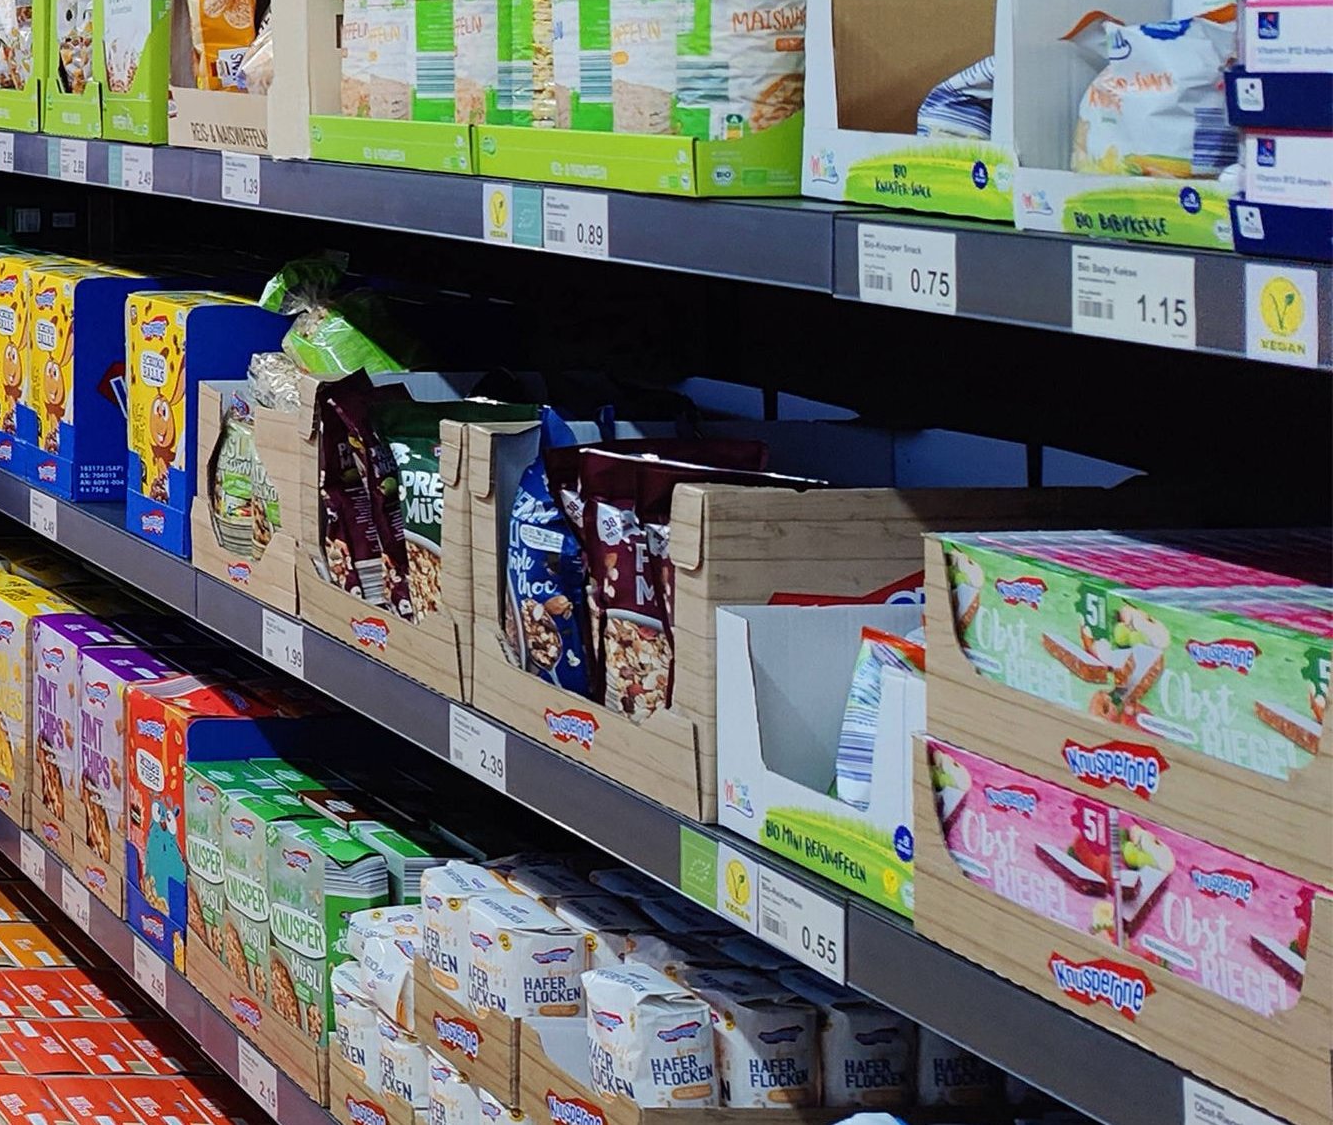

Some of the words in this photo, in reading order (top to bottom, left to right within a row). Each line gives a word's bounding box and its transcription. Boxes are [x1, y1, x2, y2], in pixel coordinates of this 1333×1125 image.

[892, 163, 908, 178] BIO
[242, 178, 259, 196] 1.39
[577, 223, 604, 246] 0.89
[1074, 211, 1093, 229] BIO
[910, 267, 950, 298] 0.75
[1137, 294, 1188, 327] 1.15
[1260, 338, 1306, 356] VEGAN
[974, 607, 1031, 655] Obst
[284, 645, 303, 668] 1.99
[1188, 641, 1256, 670] Knusperone
[37, 675, 59, 714] ZIMT
[1159, 668, 1235, 727] Obst
[37, 707, 64, 750] CHIPS
[81, 709, 104, 752] ZIMT
[81, 747, 111, 791] CHIPS
[480, 749, 504, 778] 2.39
[1066, 743, 1160, 795] Knusperone
[765, 819, 781, 843] BIO
[782, 826, 803, 854] MINI
[804, 838, 867, 884] REISWAFFELN
[961, 810, 1022, 863] Obst
[187, 840, 224, 880] KNUSPER
[225, 871, 267, 917] KNUSPER
[993, 862, 1076, 927] RIEGEL
[1193, 869, 1254, 901] Knusperone
[724, 899, 752, 923] VEGAN
[1162, 894, 1233, 953] Obst
[272, 908, 325, 954] KNUSPER
[801, 925, 837, 965] 0.55
[291, 954, 324, 994] MÜSLI
[524, 975, 567, 990] HAFER
[1053, 961, 1146, 1013] Knusperone
[524, 987, 581, 1003] FLOCKEN
[651, 1054, 698, 1073] HAFER
[652, 1065, 714, 1086] FLOCKEN
[749, 1058, 797, 1074] HAFER
[750, 1069, 809, 1088] FLOCKEN
[844, 1058, 892, 1074] HAFER
